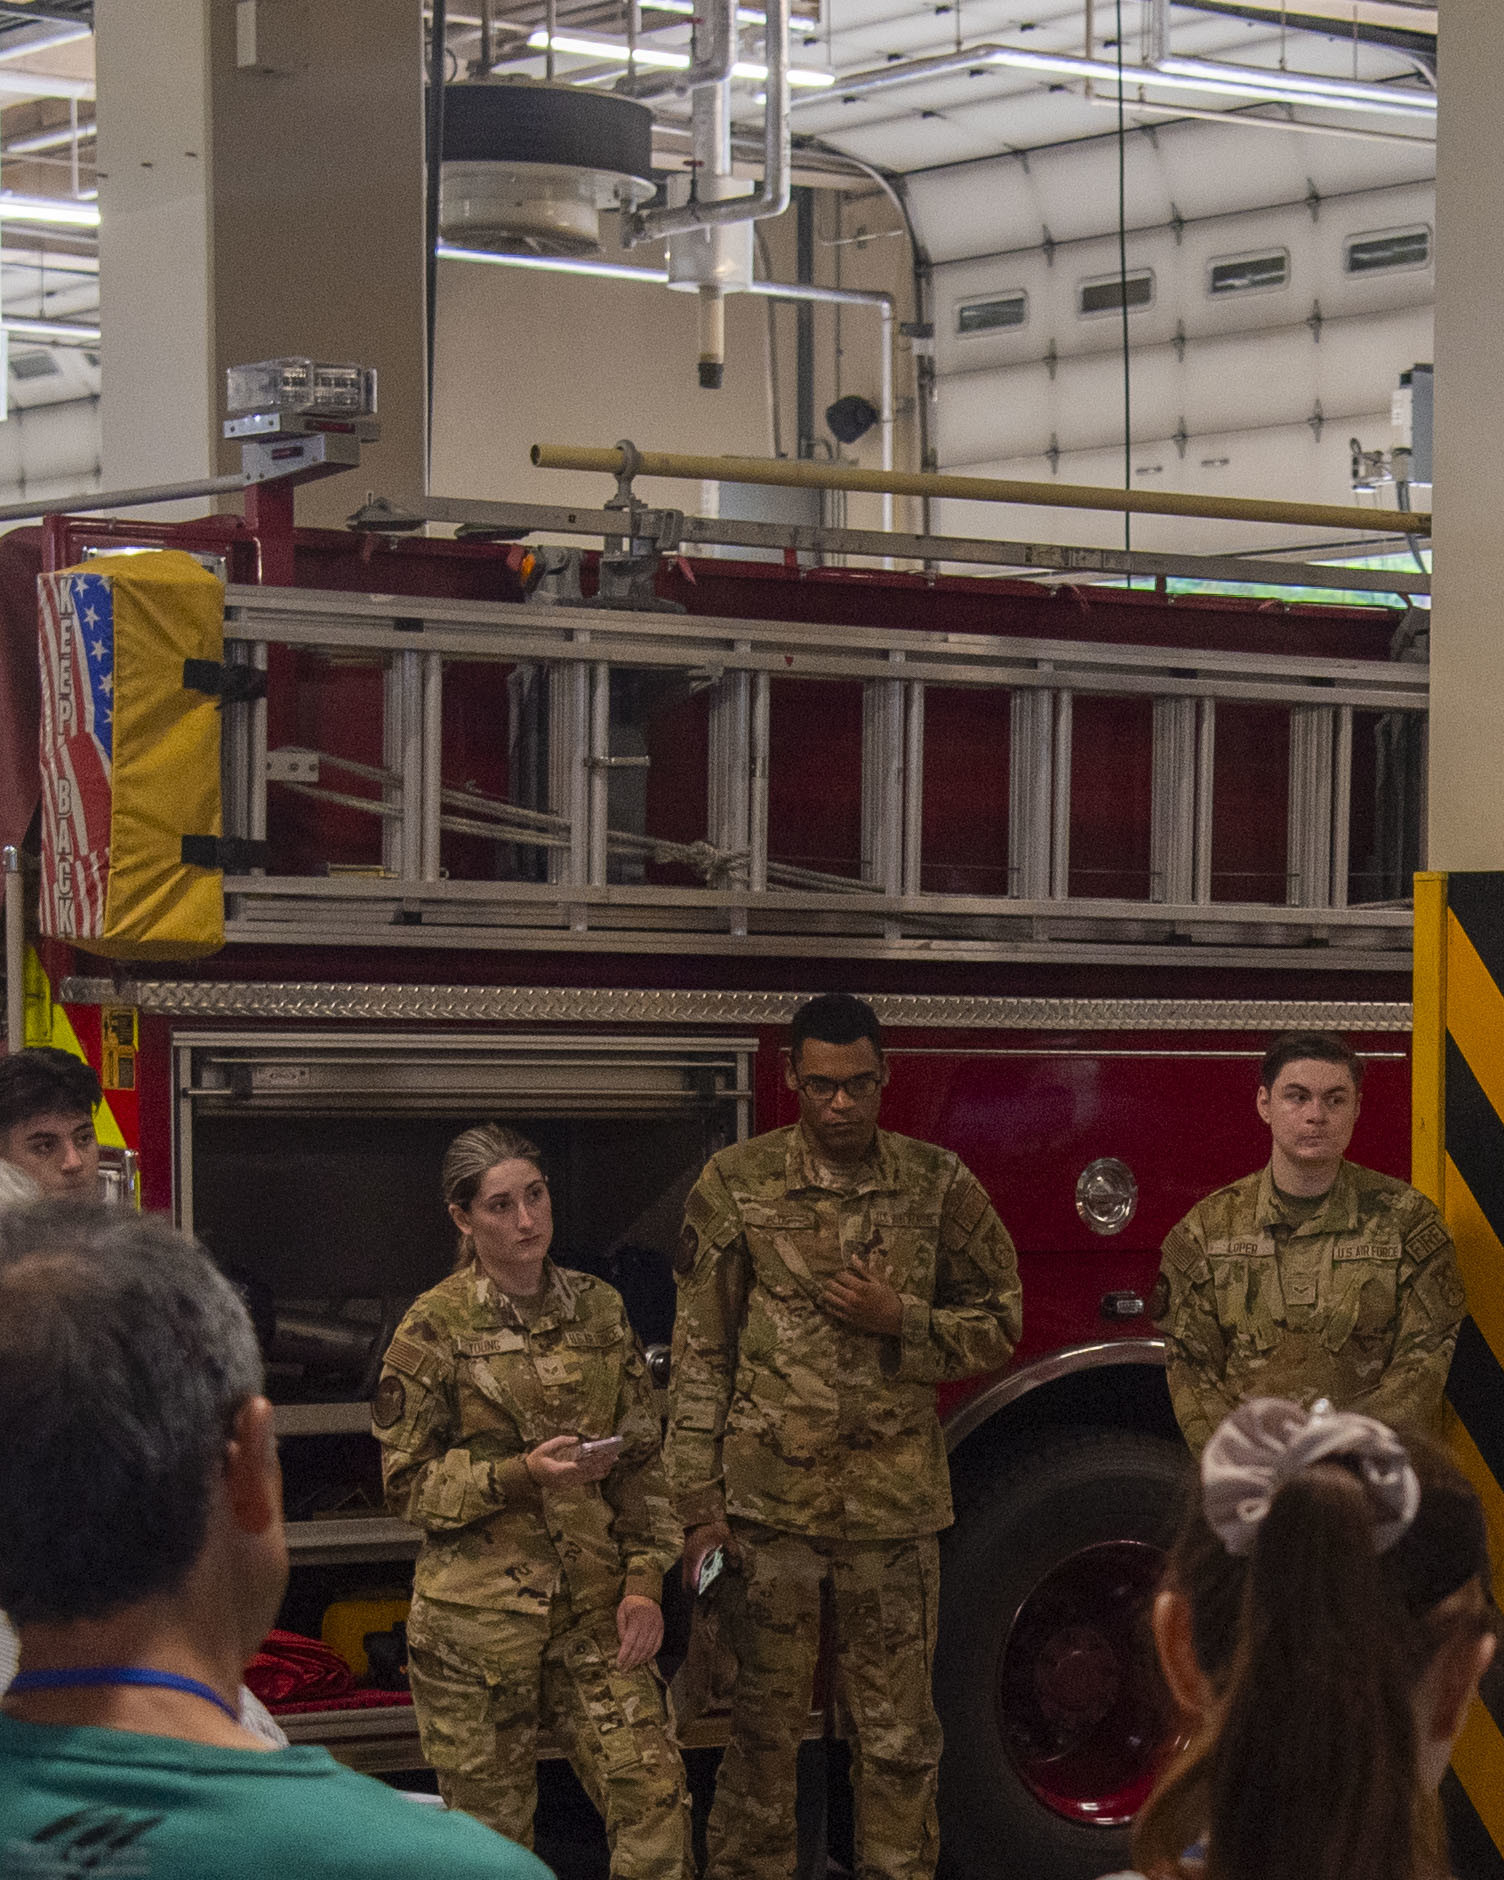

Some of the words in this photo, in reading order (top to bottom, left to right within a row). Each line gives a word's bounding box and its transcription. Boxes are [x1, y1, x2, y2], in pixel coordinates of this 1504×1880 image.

[58, 577, 75, 735] KEEP
[57, 778, 74, 936] BACK
[1227, 1242, 1258, 1254] LOPER
[1371, 1246, 1399, 1258] FORCE
[469, 1340, 501, 1354] YOUNG
